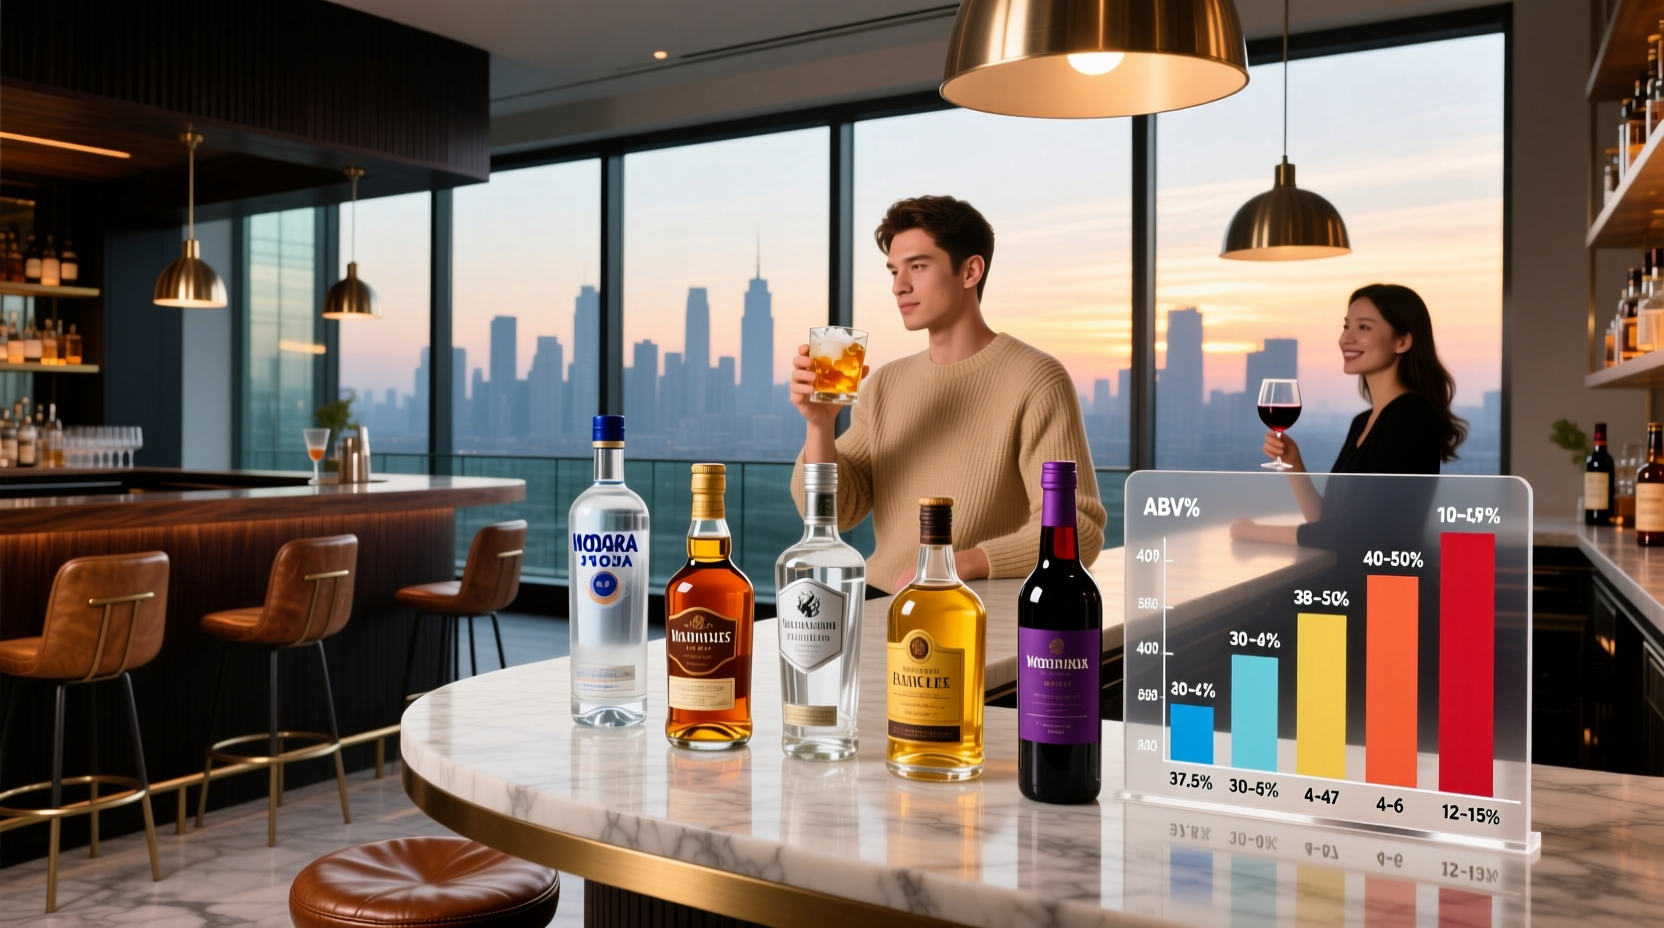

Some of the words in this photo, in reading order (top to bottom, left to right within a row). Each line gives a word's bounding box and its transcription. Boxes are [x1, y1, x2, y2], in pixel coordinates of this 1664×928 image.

[1143, 497, 1200, 518] ABV%
[1363, 550, 1424, 568] 40-50%
[1169, 771, 1213, 790] 37.5%
[1304, 787, 1340, 805] 4-47
[1376, 797, 1404, 813] 4-6
[1441, 804, 1500, 825] 12-15%
